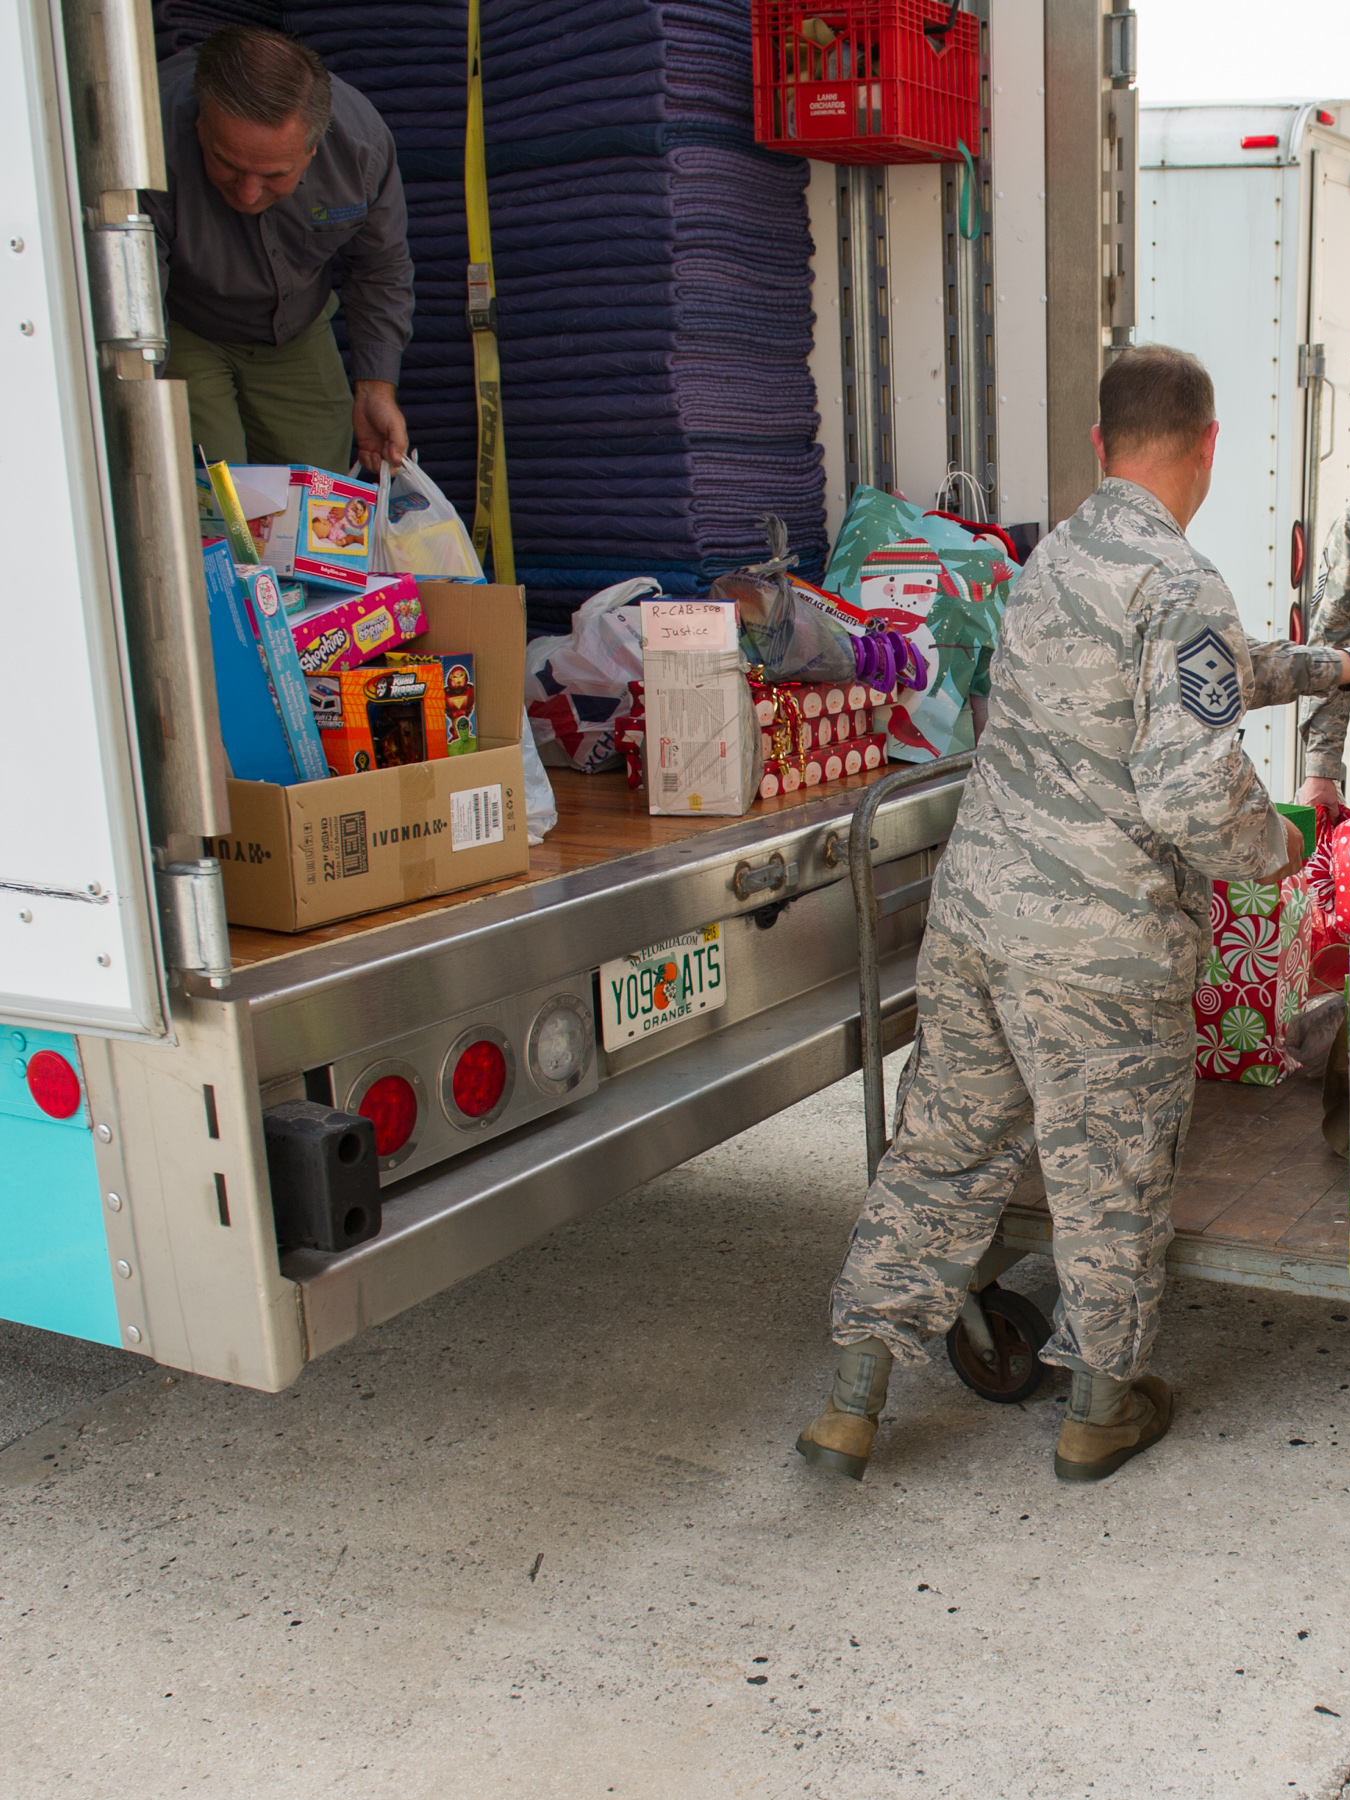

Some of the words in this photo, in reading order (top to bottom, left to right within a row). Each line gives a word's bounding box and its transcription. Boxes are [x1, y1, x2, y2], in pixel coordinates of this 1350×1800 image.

[809, 101, 846, 110] ORCHARDS
[311, 469, 334, 491] Baby
[652, 604, 721, 618] R-CAB-508
[825, 604, 858, 627] BRACELETS
[358, 620, 390, 642] SPRINT
[661, 625, 709, 638] Justice
[299, 628, 346, 672] Shopkins
[682, 944, 721, 1000] ATS
[643, 1002, 693, 1031] ORANGE
